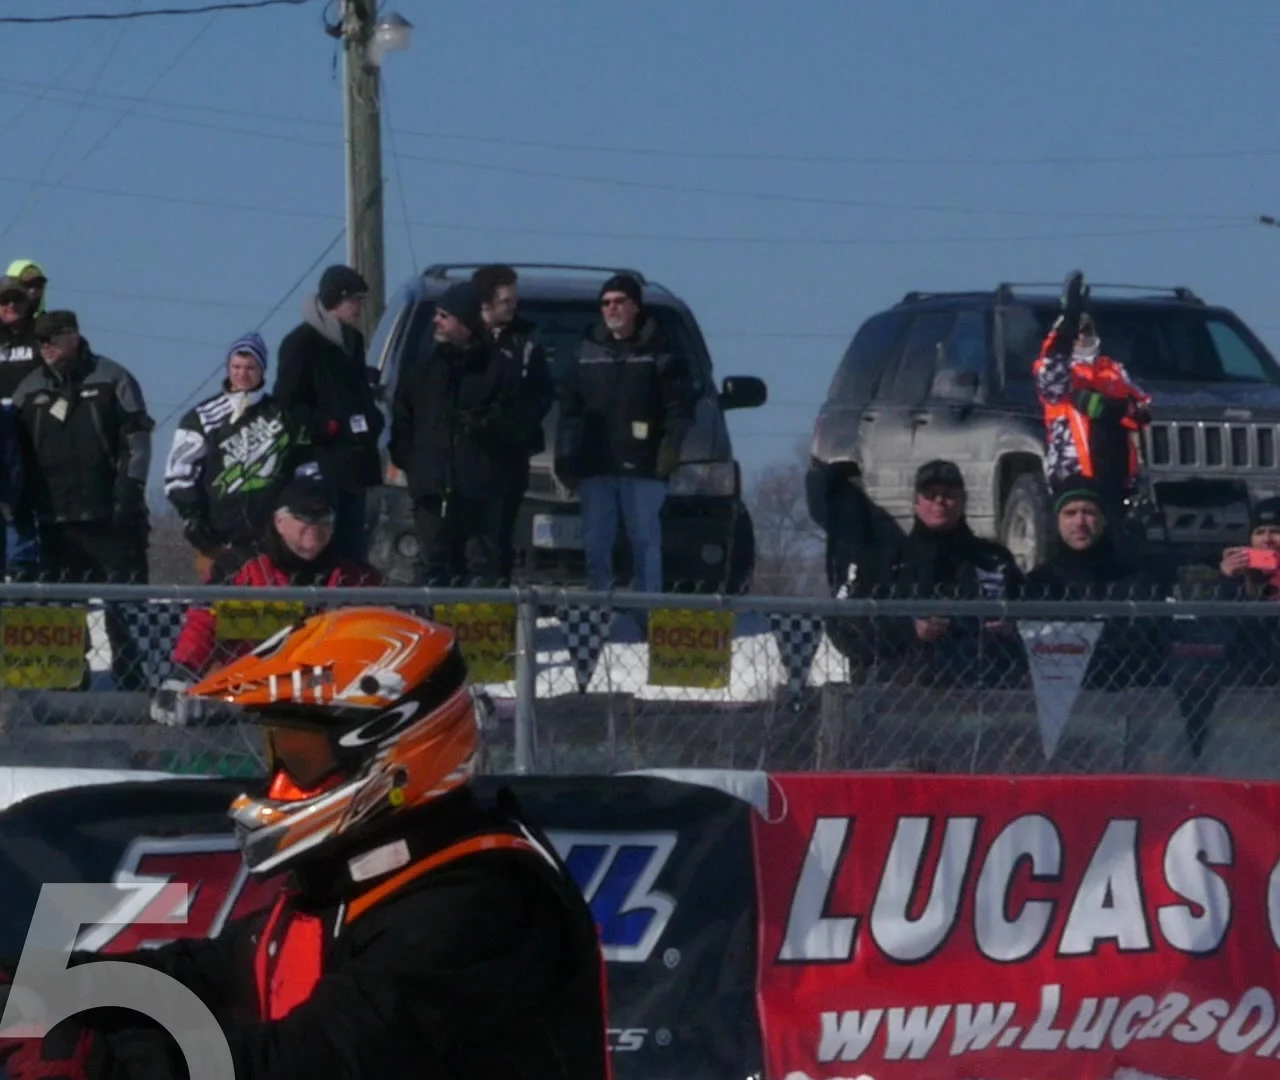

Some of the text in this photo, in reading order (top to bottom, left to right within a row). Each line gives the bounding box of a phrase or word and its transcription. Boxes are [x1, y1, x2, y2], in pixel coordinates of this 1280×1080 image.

[4, 625, 82, 647] BOSCH
[454, 620, 514, 642] OSCH
[653, 627, 730, 650] BOSCH
[773, 815, 1234, 965] LUCAS
